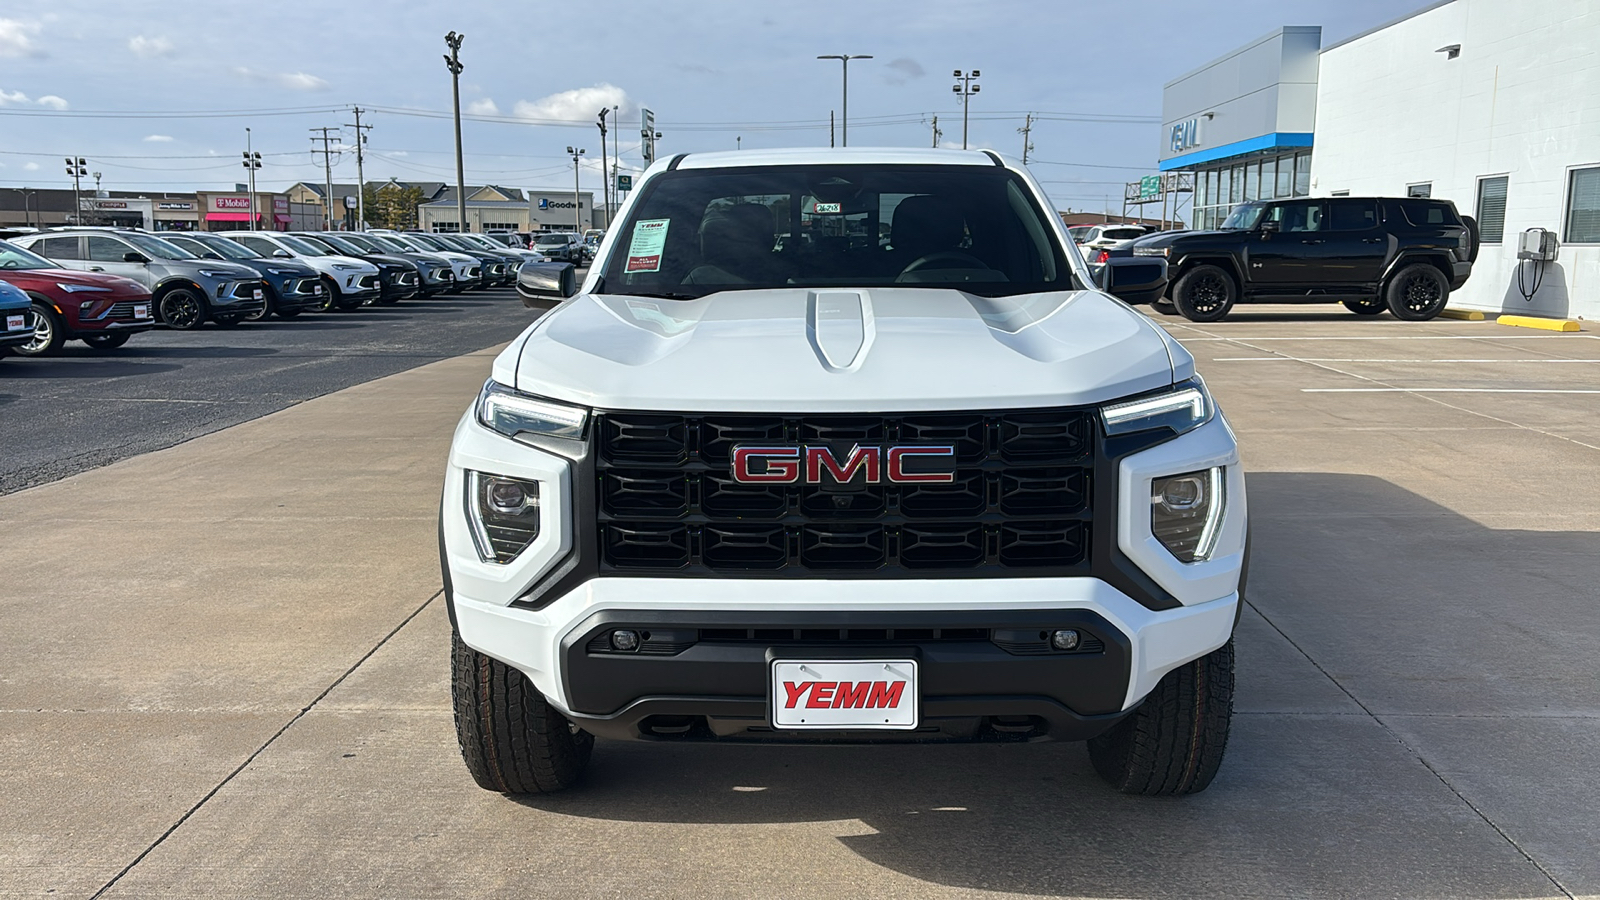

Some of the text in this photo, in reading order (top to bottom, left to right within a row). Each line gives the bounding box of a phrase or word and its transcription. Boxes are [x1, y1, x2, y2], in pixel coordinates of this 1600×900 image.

[548, 201, 583, 209] Goodwll
[733, 443, 954, 484] GMC
[783, 680, 906, 709] YEMM
